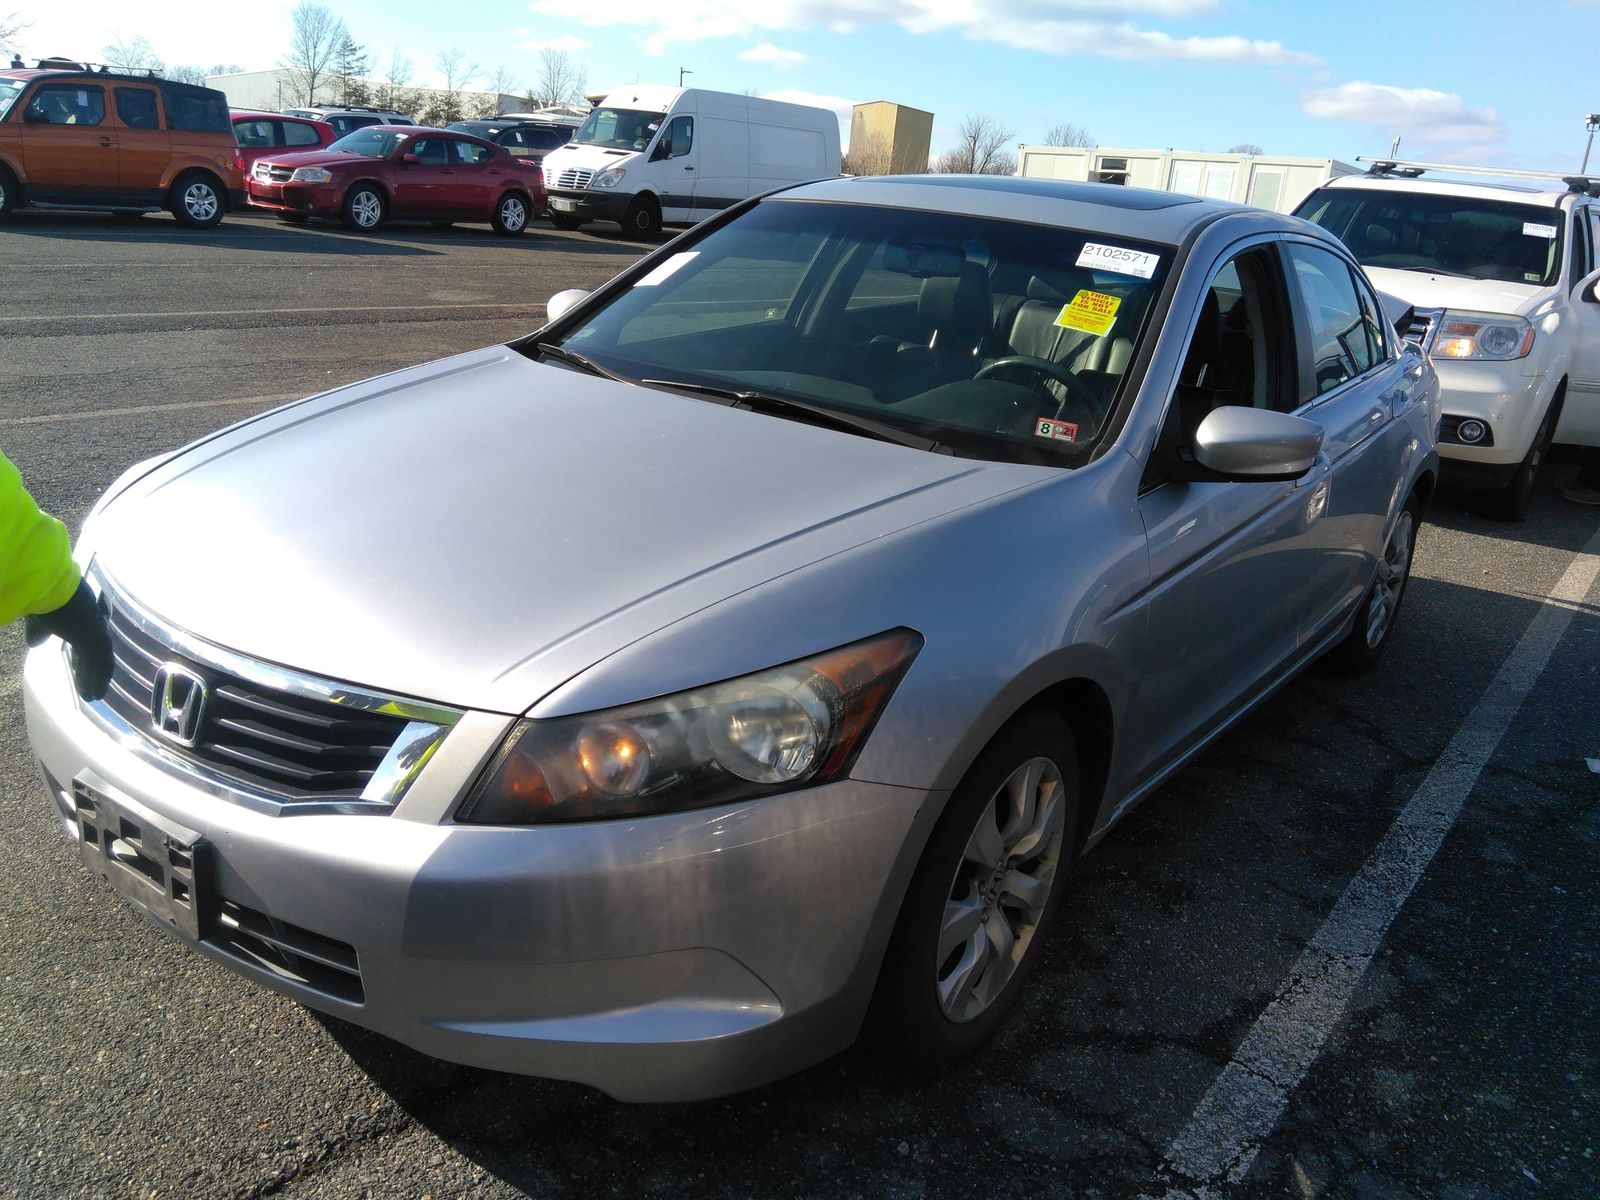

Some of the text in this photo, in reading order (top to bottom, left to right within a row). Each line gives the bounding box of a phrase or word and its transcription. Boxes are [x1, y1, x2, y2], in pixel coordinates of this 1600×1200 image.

[1083, 245, 1149, 264] 2102571
[1081, 295, 1114, 306] VEHICLE
[1091, 306, 1112, 315] SALE
[1040, 423, 1050, 434] 8
